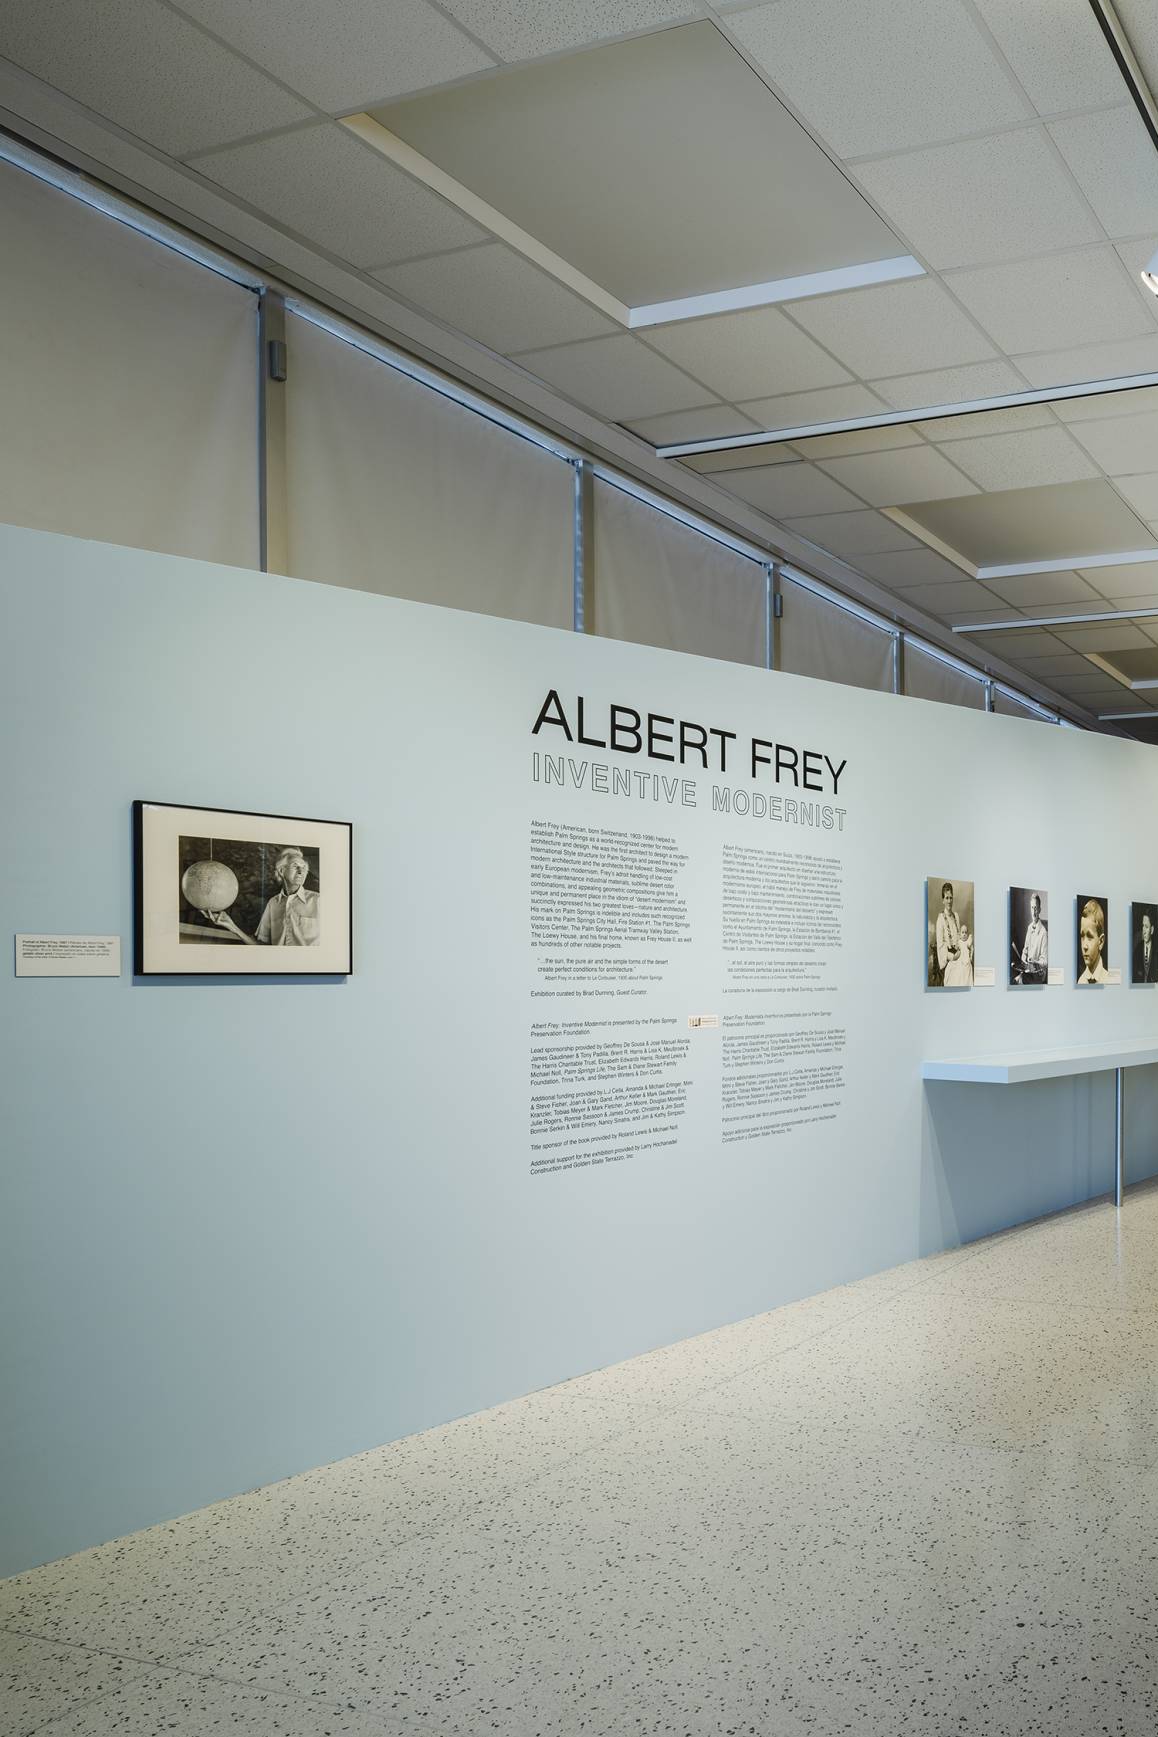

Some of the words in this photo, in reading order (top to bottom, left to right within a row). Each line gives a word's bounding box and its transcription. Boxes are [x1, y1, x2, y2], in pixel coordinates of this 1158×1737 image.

[531, 689, 736, 772] ALBERT
[752, 737, 848, 795] FREY
[533, 752, 697, 808] INVENTIVE
[712, 785, 847, 831] MODERNIST
